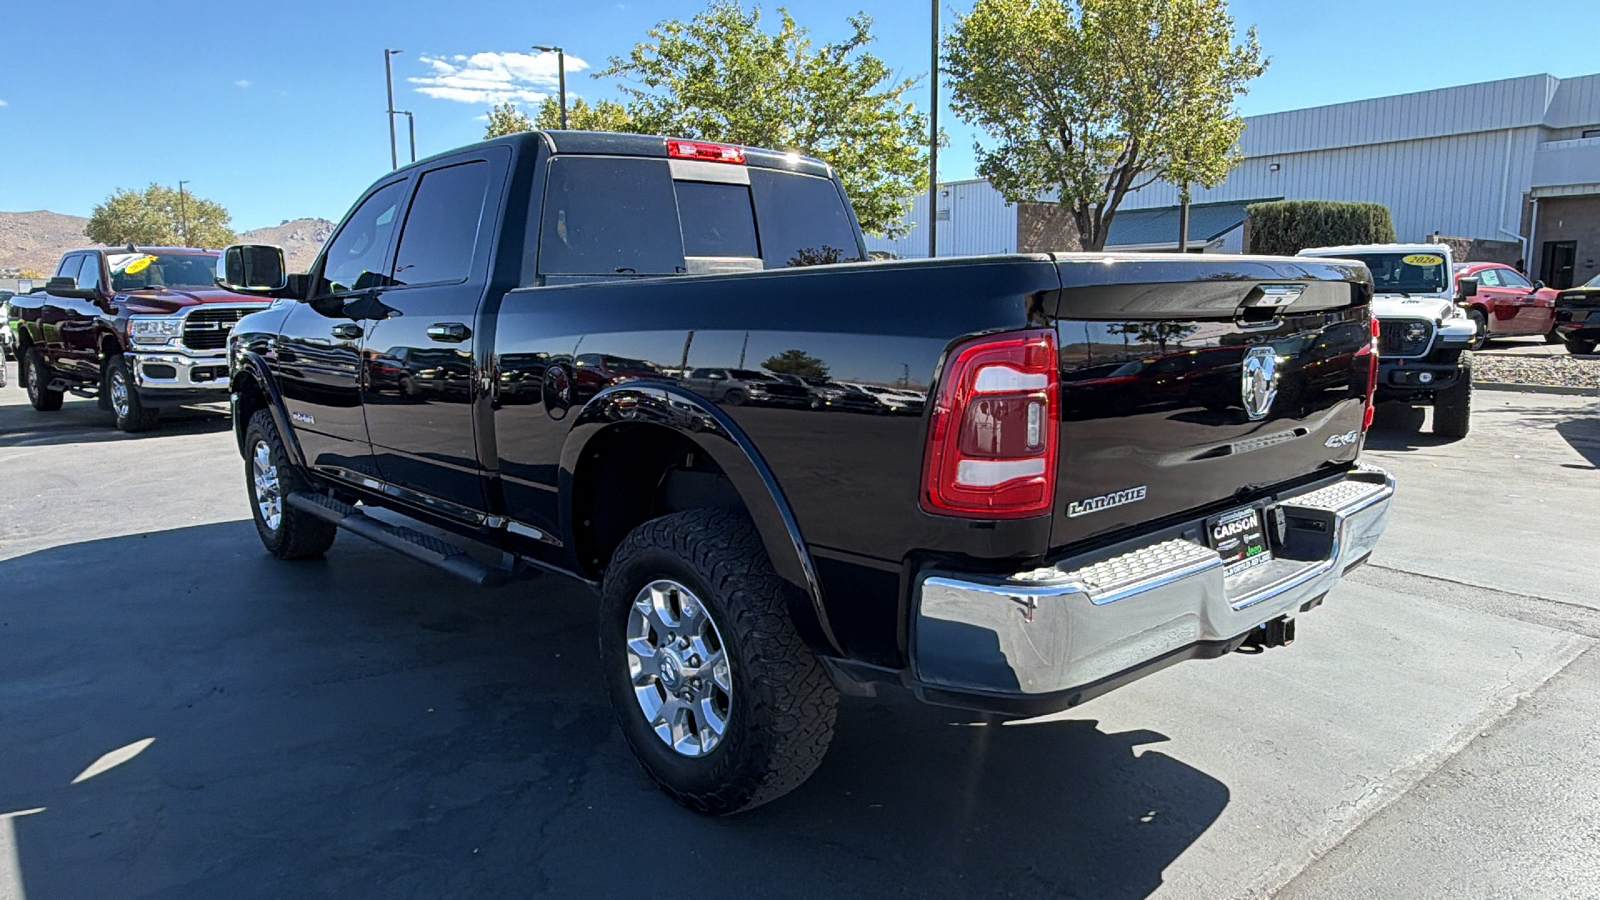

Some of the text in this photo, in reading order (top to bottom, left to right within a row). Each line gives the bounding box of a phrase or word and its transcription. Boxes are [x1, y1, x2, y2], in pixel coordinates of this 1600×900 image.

[1409, 256, 1436, 264] 2026
[1067, 485, 1147, 518] LARAMIE
[1214, 513, 1258, 539] CARSON
[1246, 544, 1262, 557] Jeep
